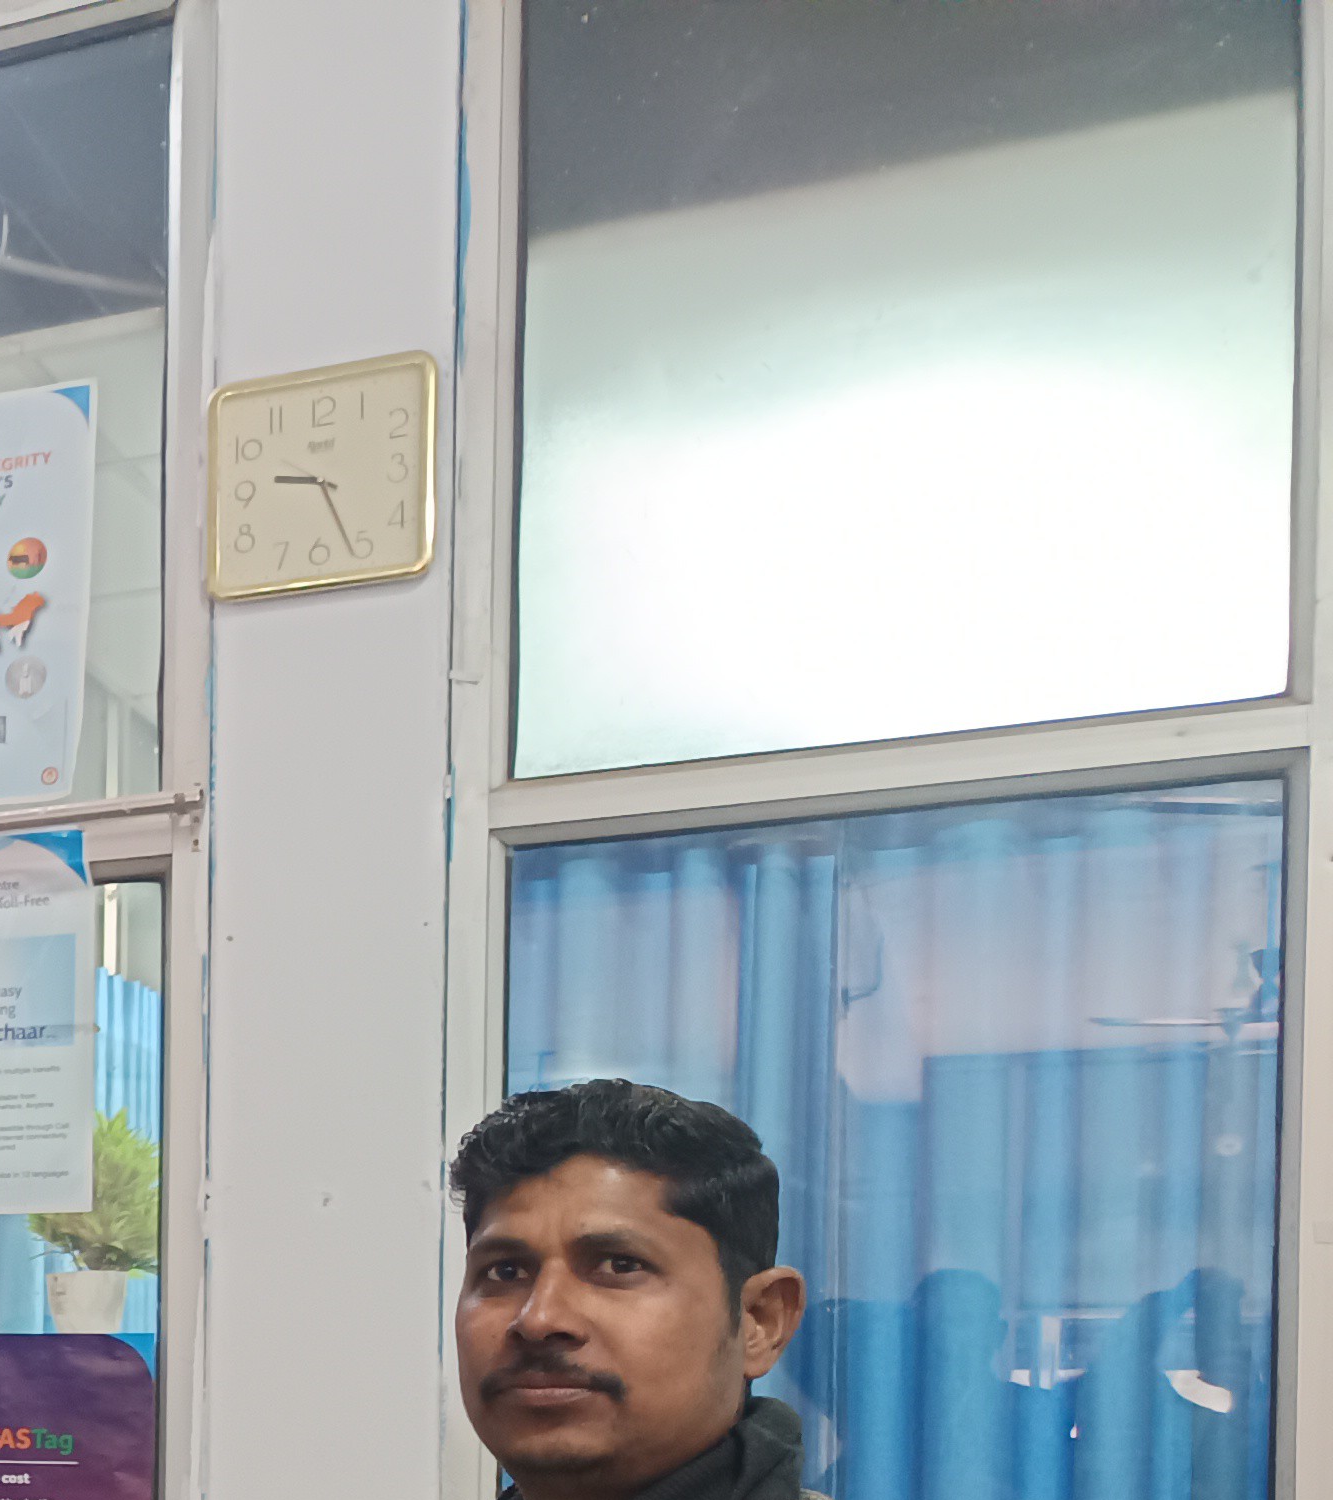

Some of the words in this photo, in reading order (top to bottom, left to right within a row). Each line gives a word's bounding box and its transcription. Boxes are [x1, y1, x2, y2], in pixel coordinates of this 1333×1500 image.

[269, 405, 283, 435] 11
[311, 396, 337, 428] 12
[389, 407, 409, 439] 2
[234, 435, 263, 464] 10
[386, 453, 409, 483] 3
[234, 480, 256, 509] 9
[386, 500, 407, 529] 4
[233, 524, 256, 554] 8
[308, 537, 331, 566] 6
[354, 530, 374, 559] 5
[274, 541, 290, 571] 7
[1, 1472, 31, 1485] cost
